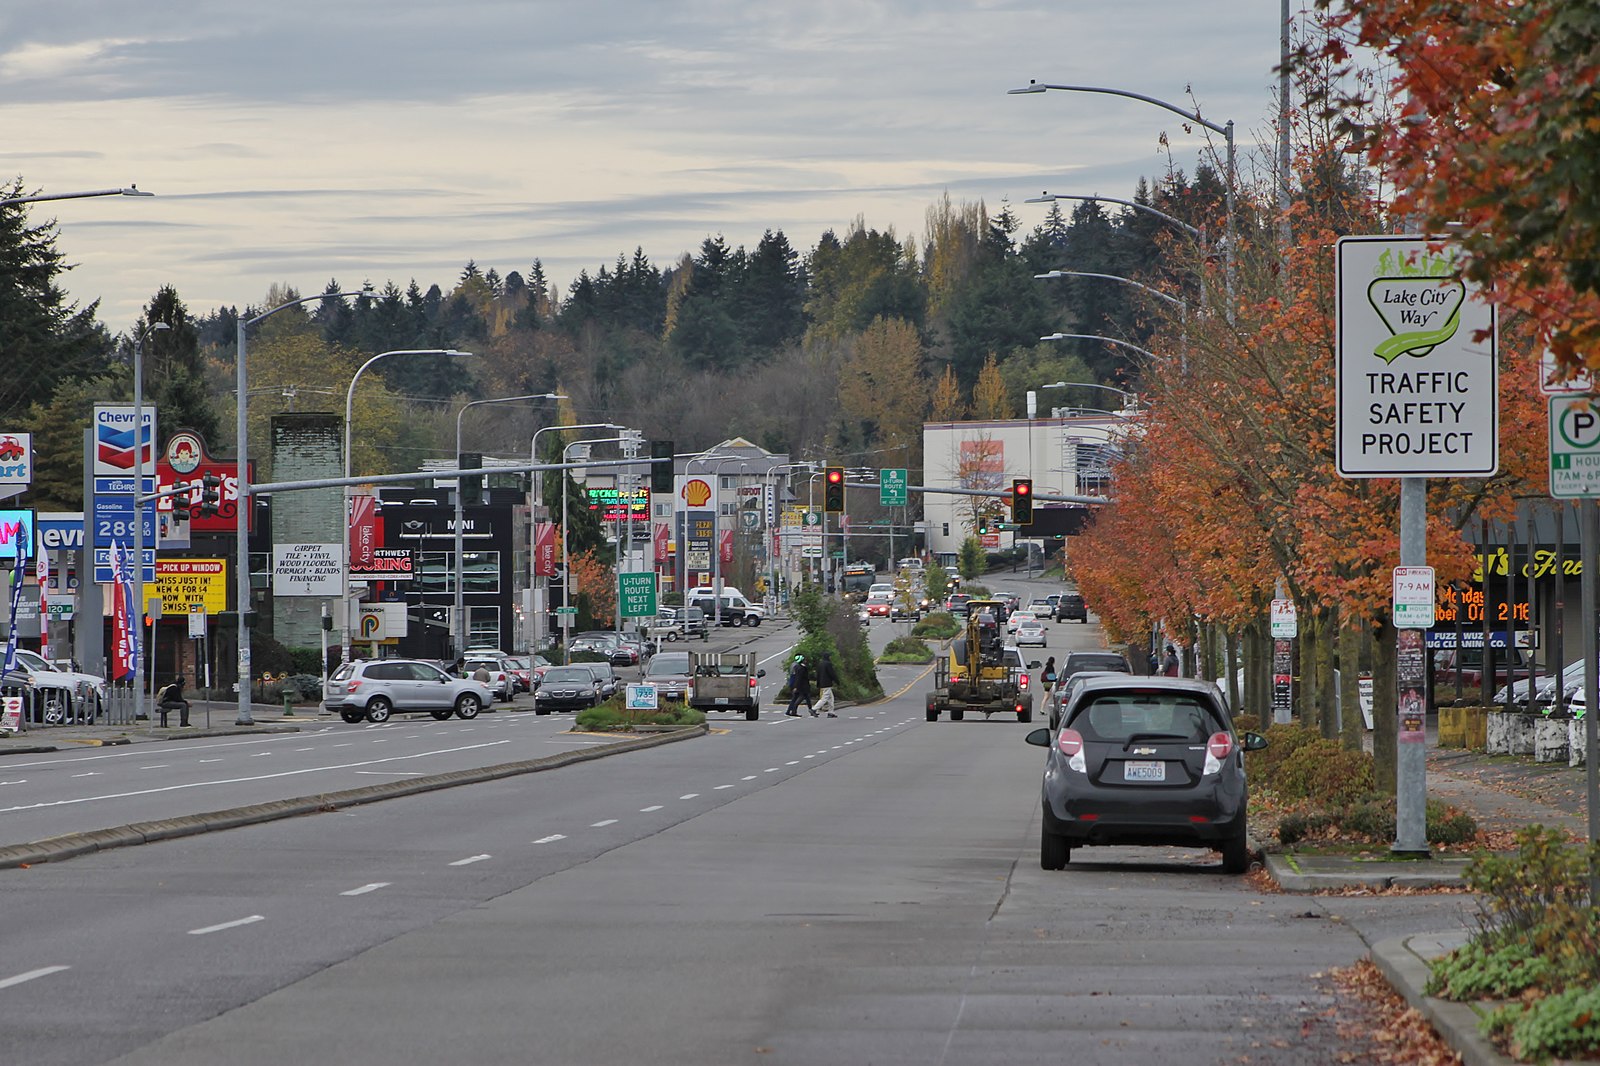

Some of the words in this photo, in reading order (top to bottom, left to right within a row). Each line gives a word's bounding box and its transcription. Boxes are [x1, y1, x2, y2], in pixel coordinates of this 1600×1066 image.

[1384, 289, 1418, 306] Lake
[1420, 289, 1456, 306] City
[1400, 310, 1438, 327] Way
[1366, 372, 1469, 394] TRAFFIC
[98, 411, 151, 423] Chevrn
[1369, 402, 1466, 424] SAFETY
[1574, 413, 1595, 438] P
[1362, 432, 1473, 455] PROJECT
[108, 483, 135, 491] TECHRO
[447, 520, 474, 530] MNI
[362, 526, 373, 545] lake
[360, 546, 371, 564] city
[374, 549, 411, 557] RTHWEST
[162, 564, 178, 572] PICK
[180, 564, 190, 572] UP
[192, 564, 220, 572] WINDOW
[623, 577, 652, 586] U-TURN
[624, 586, 650, 595] ROUTE
[1398, 582, 1414, 591] 7-9
[1416, 583, 1430, 591] AM
[627, 596, 648, 604] NEXT
[48, 605, 63, 613] 120
[163, 603, 187, 611] SWISS
[628, 604, 648, 613] LEFT
[1434, 604, 1457, 621] ber
[1434, 632, 1457, 640] FUZZ
[1463, 632, 1494, 640] WUZY
[1426, 640, 1441, 648] UG
[1490, 640, 1507, 648] CO.
[1127, 767, 1163, 778] AWE5009
